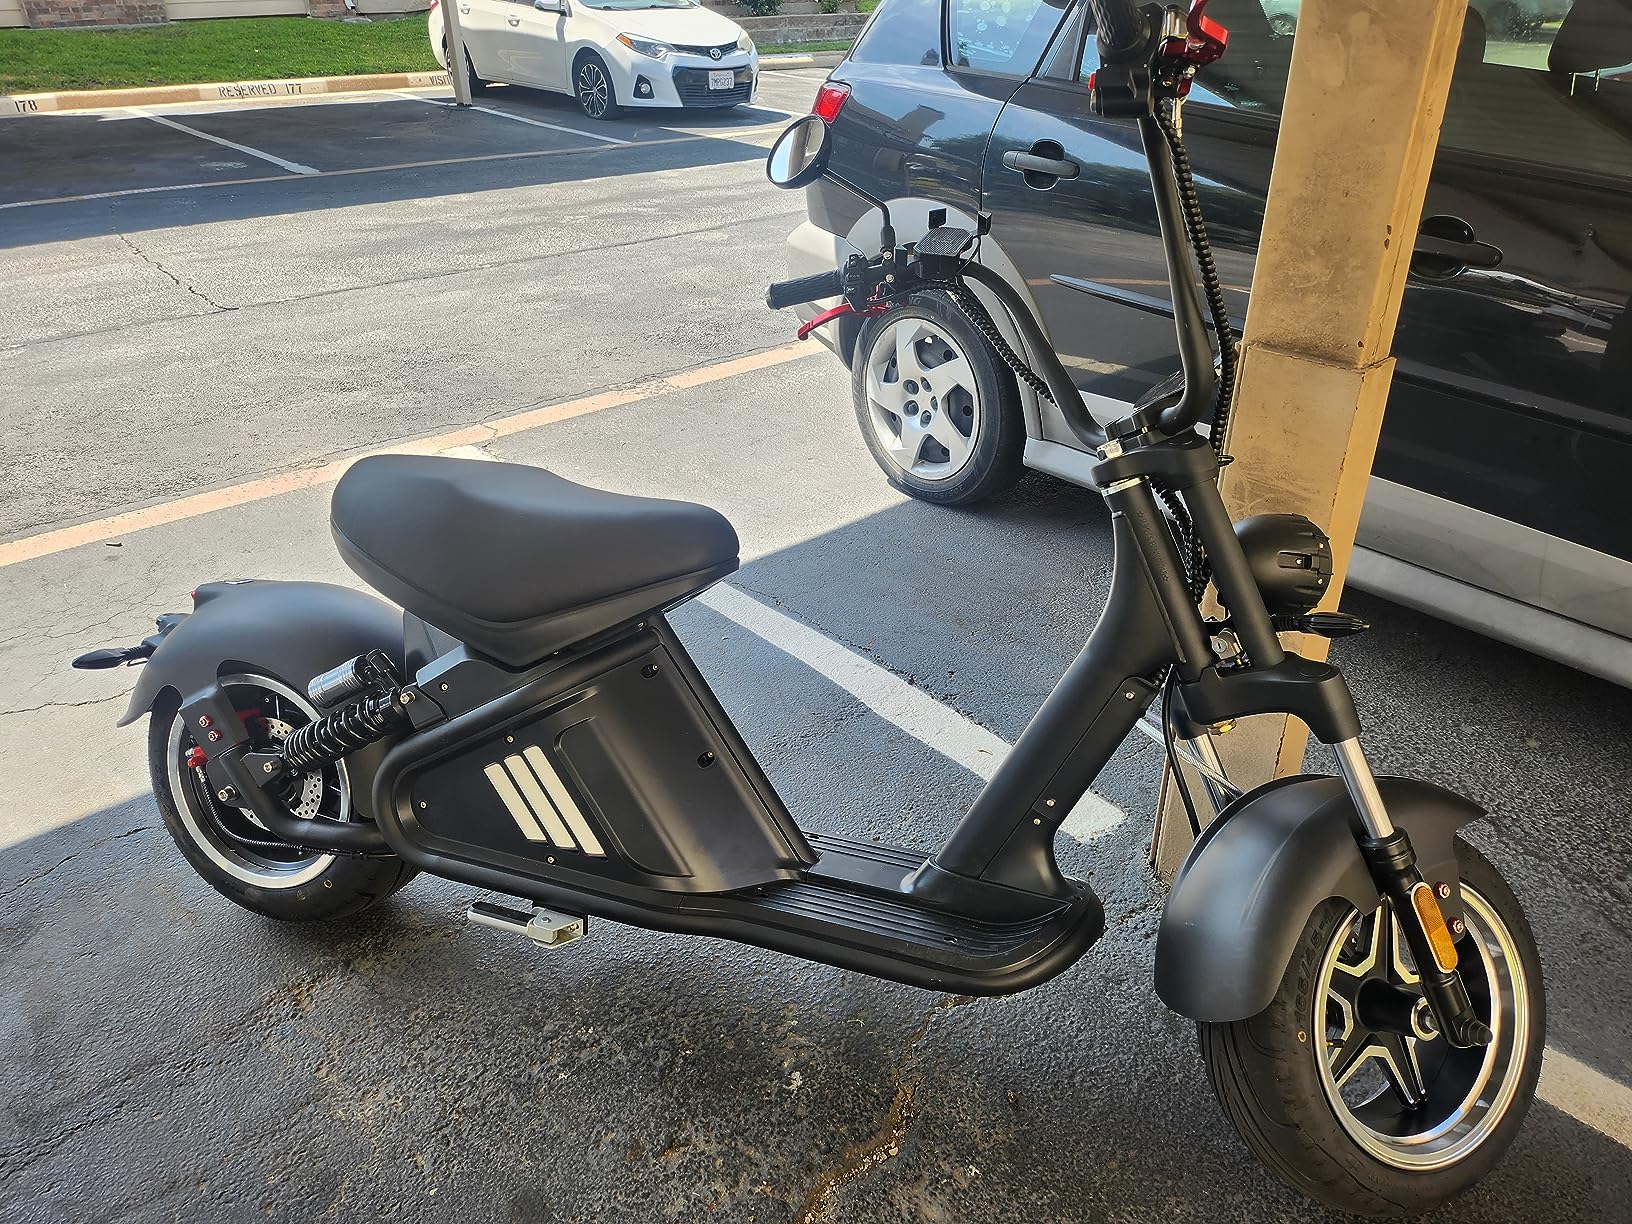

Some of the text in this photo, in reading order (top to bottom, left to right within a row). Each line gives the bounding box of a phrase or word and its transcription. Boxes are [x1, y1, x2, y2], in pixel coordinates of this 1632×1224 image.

[429, 74, 450, 86] VISIT
[218, 83, 302, 98] RESERVED 177
[15, 100, 38, 112] 178
